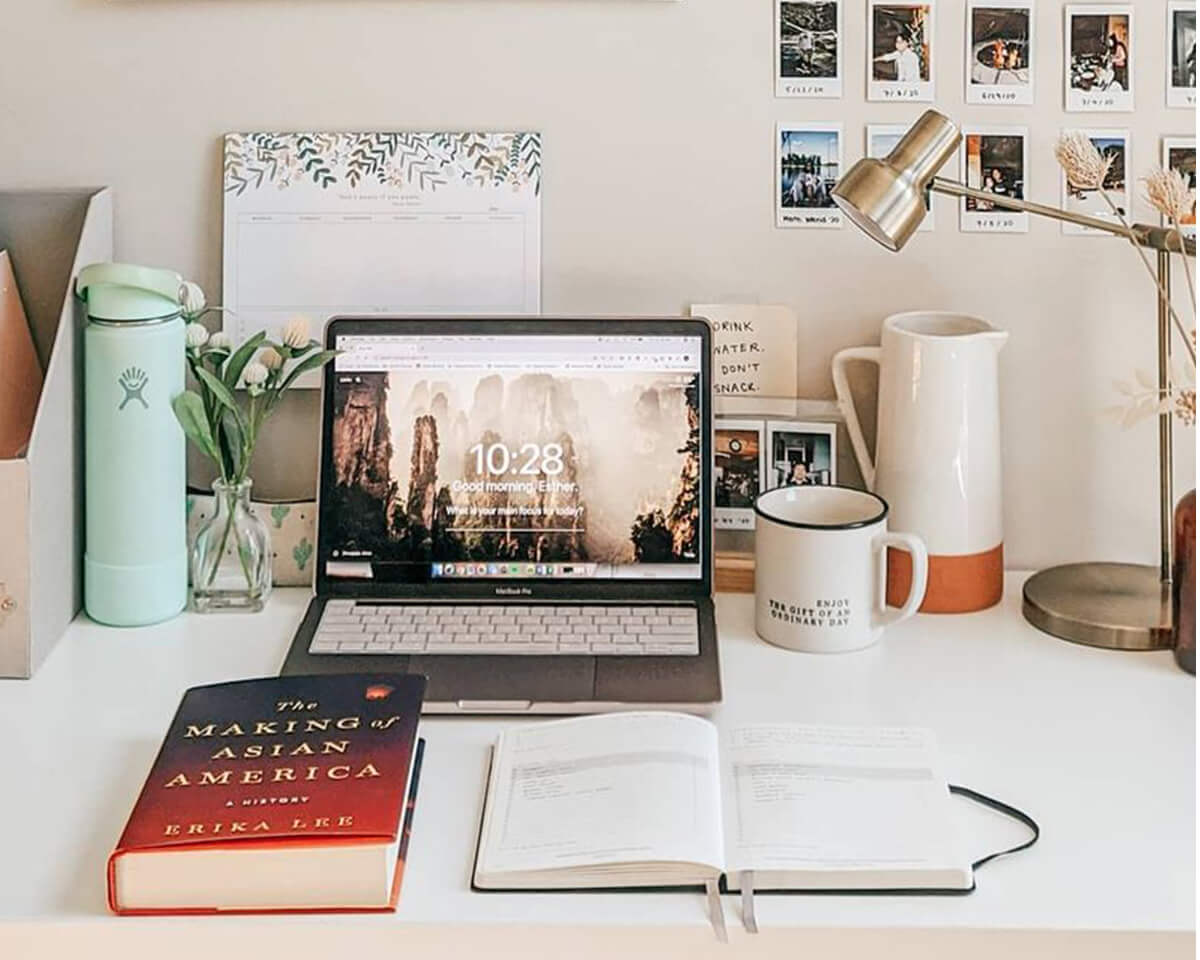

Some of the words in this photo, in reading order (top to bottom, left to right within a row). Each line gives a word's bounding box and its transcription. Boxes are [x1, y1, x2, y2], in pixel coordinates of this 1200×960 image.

[712, 321, 754, 332] DRINK
[721, 363, 761, 376] DON'T
[713, 382, 760, 393] SNACK.
[470, 442, 564, 475] 10:28
[451, 480, 484, 493] Good
[446, 506, 469, 516] What
[478, 507, 497, 518] your
[498, 506, 518, 516] main
[519, 506, 541, 516] focus
[557, 506, 585, 518] today?
[816, 598, 849, 608] ENJOY
[275, 699, 320, 713] The
[183, 716, 361, 739] MAKING
[369, 715, 401, 731] of
[211, 740, 352, 761] ASIAN
[163, 762, 383, 789] AMERICA
[242, 796, 311, 807] HISTORY
[163, 820, 273, 837] ERIKA
[291, 815, 357, 830] LEE
